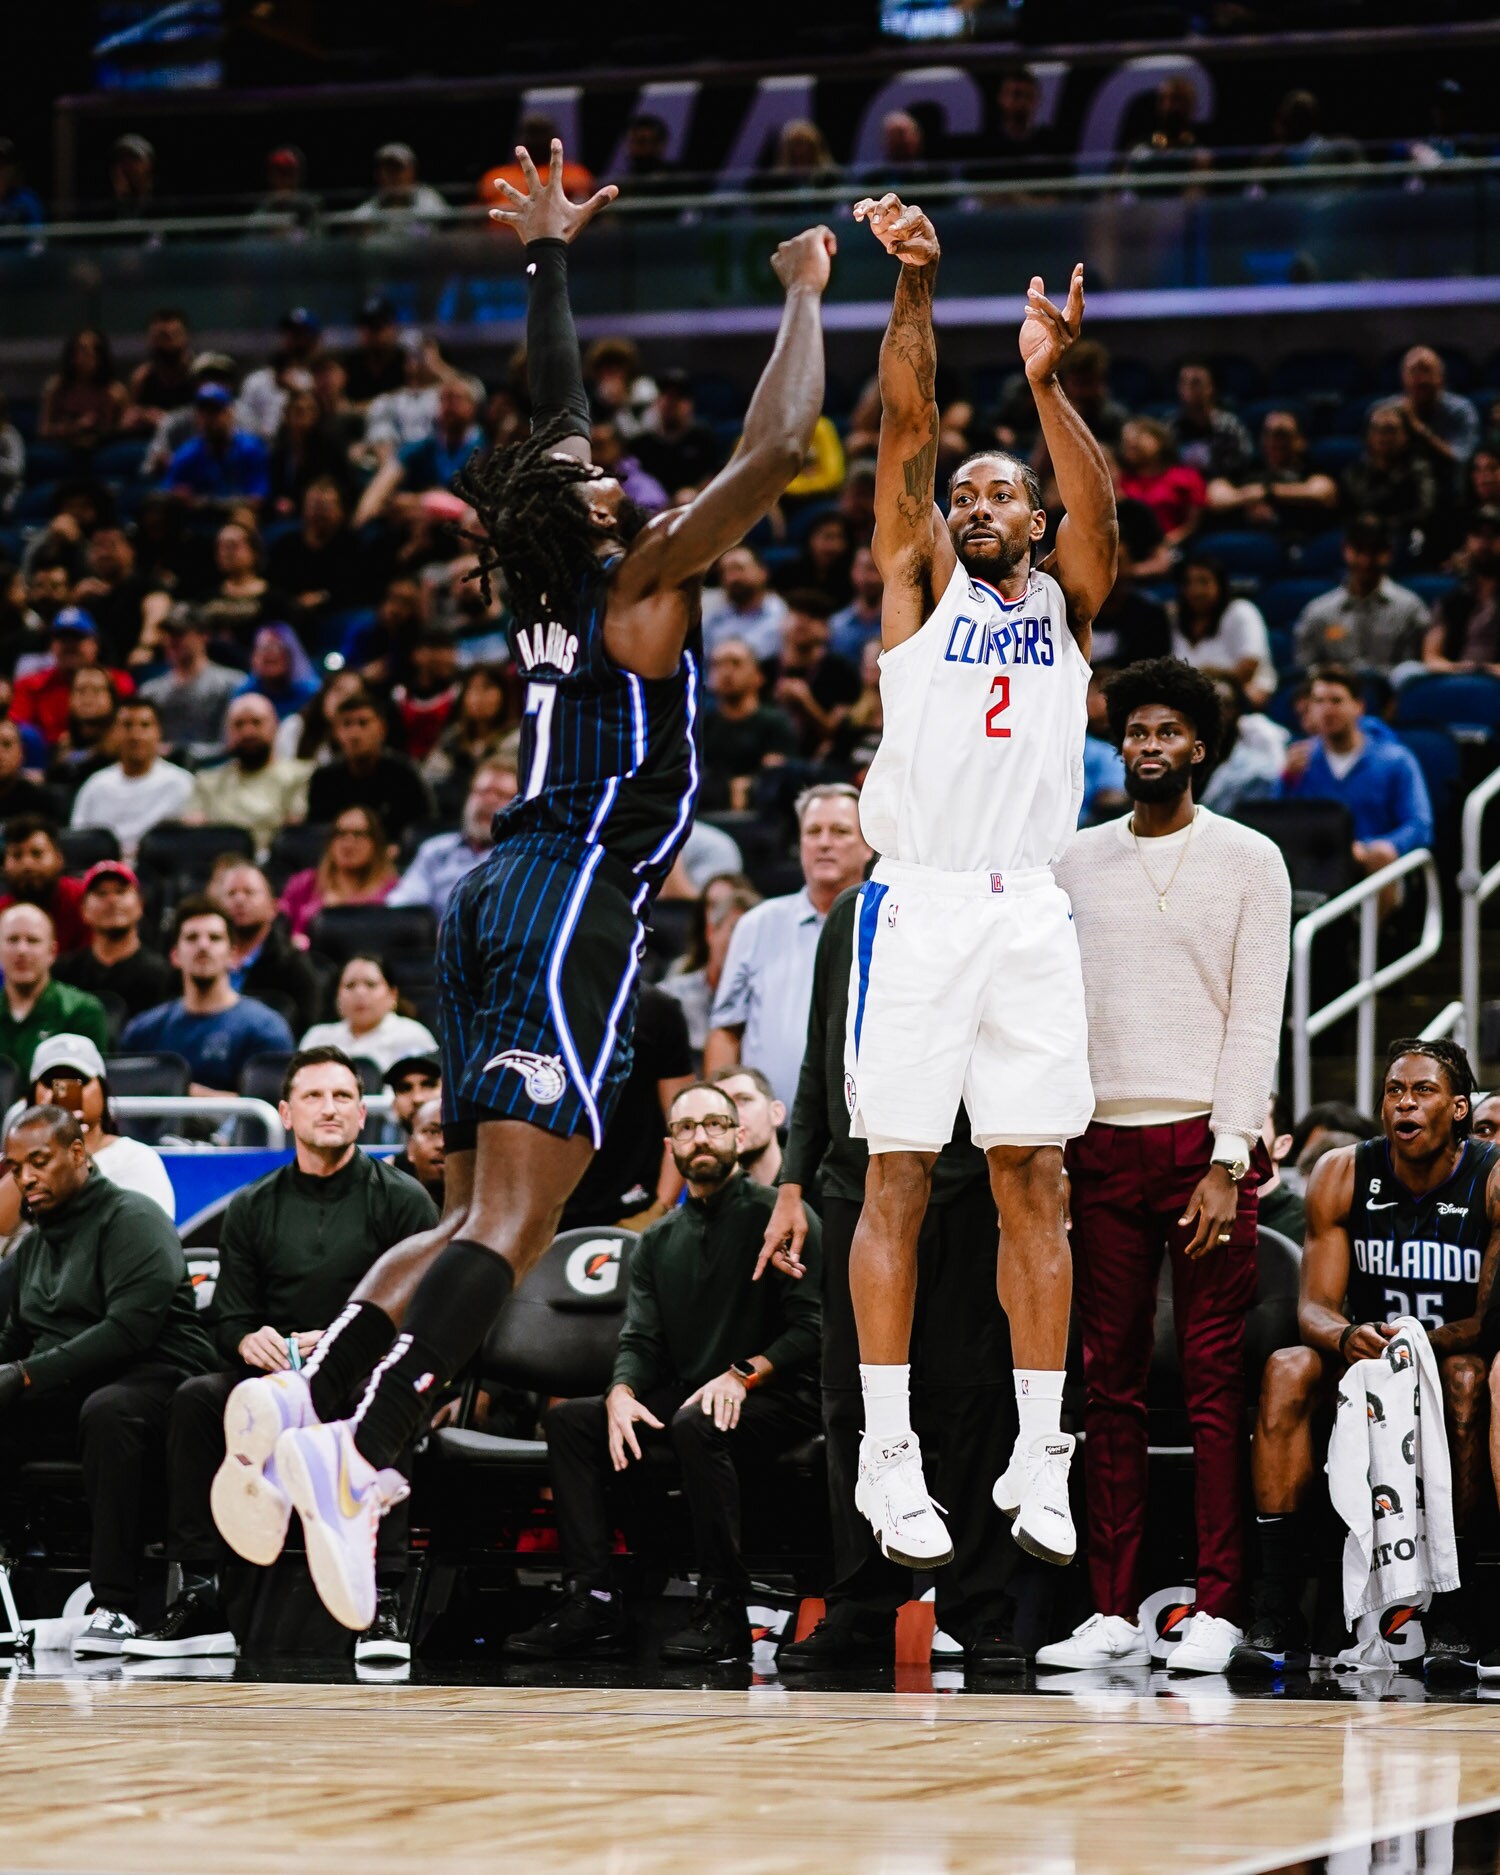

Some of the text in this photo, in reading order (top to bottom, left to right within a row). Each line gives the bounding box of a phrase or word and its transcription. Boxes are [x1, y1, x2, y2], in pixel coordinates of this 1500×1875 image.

[986, 676, 1011, 738] 2
[525, 682, 557, 801] 7
[1369, 1178, 1381, 1194] 6
[1436, 1202, 1469, 1217] Disney
[566, 1239, 623, 1295] G
[1354, 1239, 1482, 1283] ORLANDO
[1370, 1538, 1416, 1573] ATO
